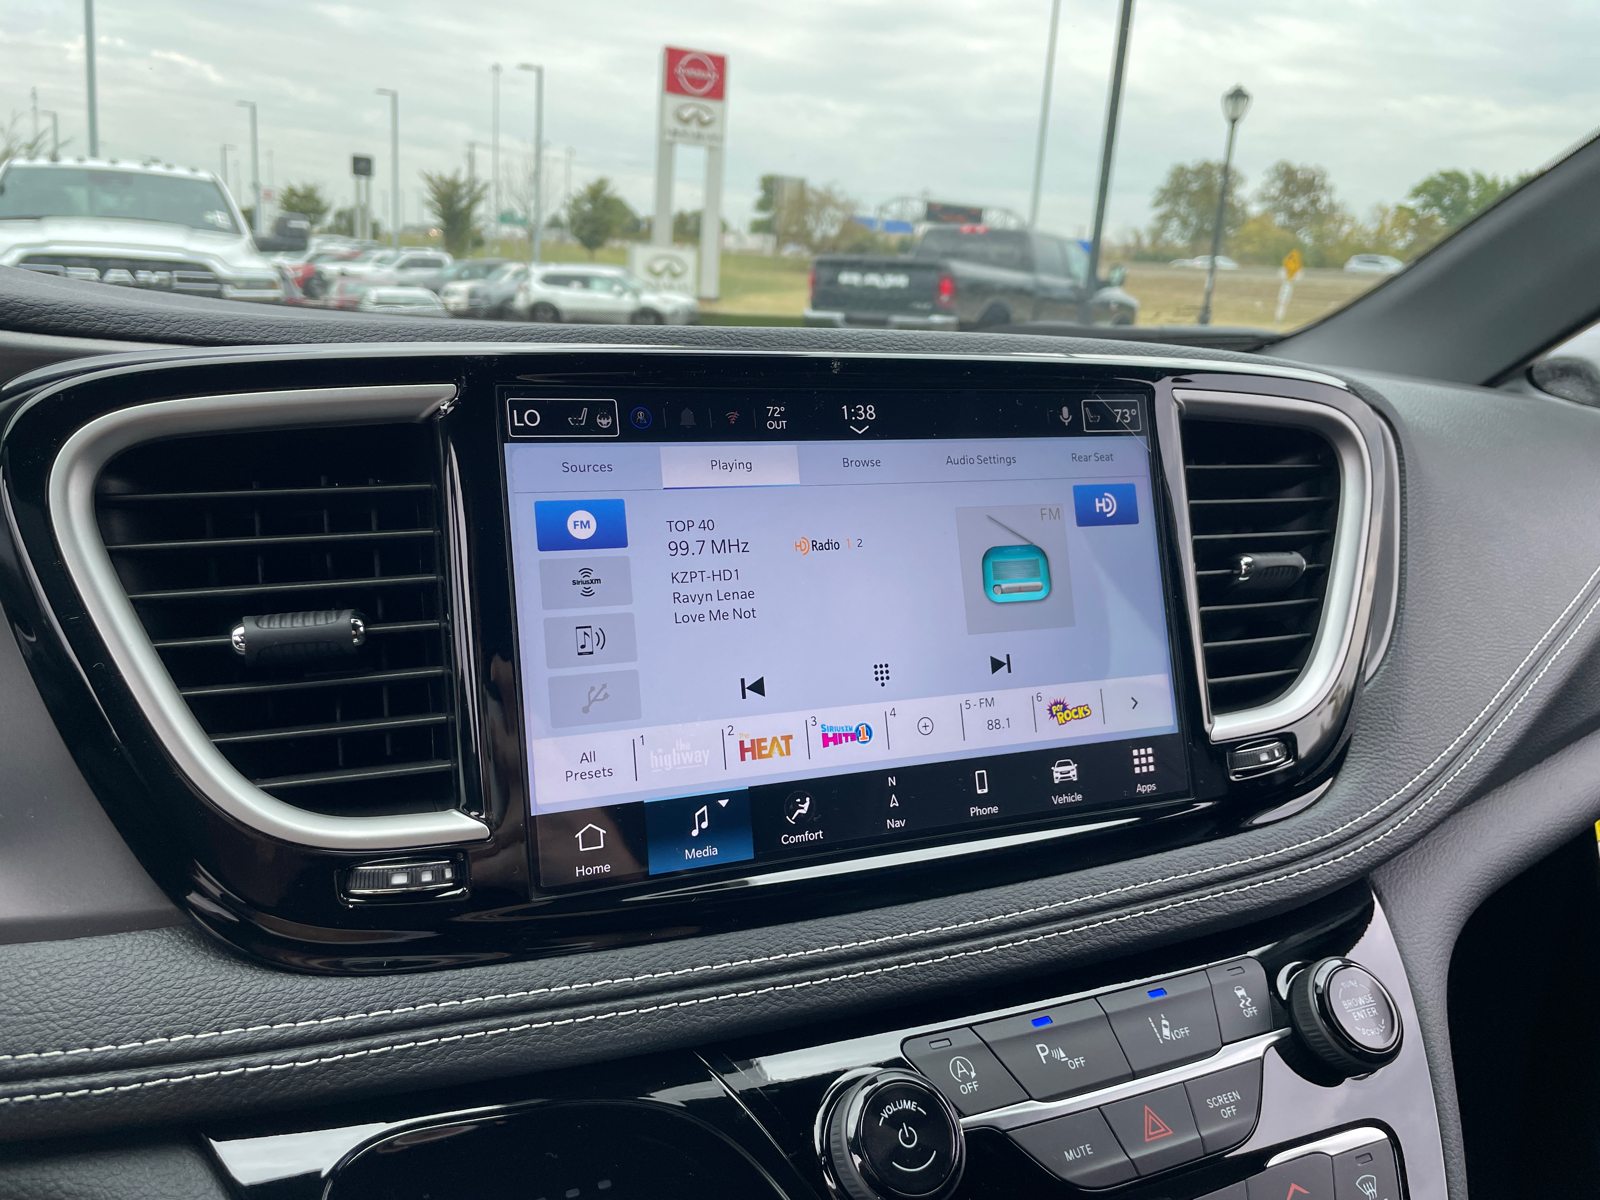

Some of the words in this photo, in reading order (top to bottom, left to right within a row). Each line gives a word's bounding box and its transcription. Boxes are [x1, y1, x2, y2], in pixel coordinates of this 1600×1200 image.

[513, 409, 541, 427] LO
[766, 406, 785, 417] 72°
[841, 404, 876, 421] 1:38
[1114, 408, 1137, 424] 73°
[766, 420, 787, 430] OUT
[842, 457, 881, 468] Browse
[945, 454, 975, 466] Audio
[976, 453, 1017, 467] Settings
[1071, 452, 1091, 463] Rear
[1093, 452, 1114, 463] Seat
[561, 461, 613, 474] Sources
[710, 459, 753, 472] Playing
[1040, 507, 1061, 521] FM
[573, 520, 591, 530] FM
[666, 520, 695, 532] TOP
[698, 519, 715, 531] 40
[668, 540, 706, 556] 99.7
[711, 539, 750, 554] MHz
[811, 539, 840, 551] Radio
[856, 538, 863, 548] 2
[671, 569, 740, 584] KZPT-HD1
[673, 591, 713, 605] Ravyn
[716, 589, 755, 601] Lenae
[674, 612, 706, 624] Love
[709, 610, 729, 621] Me
[733, 607, 757, 620] Not
[965, 700, 971, 709] 5
[979, 697, 995, 708] FM
[1036, 692, 1043, 702] 6
[889, 707, 897, 717] 4
[1057, 705, 1092, 725] ROCKS
[810, 716, 818, 727] 3
[987, 718, 1011, 731] 88.1
[727, 725, 735, 736] 2
[639, 735, 645, 746] 1
[675, 739, 690, 751] the
[739, 735, 793, 762] HEAT
[580, 750, 597, 763] All
[650, 749, 709, 771] highway
[565, 767, 614, 781] Presets
[888, 776, 896, 786] N
[1136, 783, 1157, 794] Apps
[1051, 792, 1083, 805] Vehicle
[970, 804, 999, 816] Phone
[886, 818, 906, 829] Nav
[781, 829, 824, 845] Comfort
[685, 846, 718, 860] Media
[575, 862, 611, 877] Home
[1341, 979, 1359, 989] TUNE
[1341, 993, 1375, 1010] BROWSE
[1242, 1006, 1258, 1018] OFF
[1352, 1006, 1379, 1021] ENTER
[1174, 1026, 1191, 1039] OFF
[1361, 1023, 1386, 1037] SCROLL
[1035, 1043, 1050, 1064] P
[1067, 1056, 1086, 1070] OFF
[959, 1081, 979, 1095] OFF
[1206, 1090, 1241, 1109] SCREEN
[880, 1100, 918, 1119] VOLUME
[1220, 1105, 1237, 1119] OFF
[1064, 1143, 1094, 1161] MUTE
